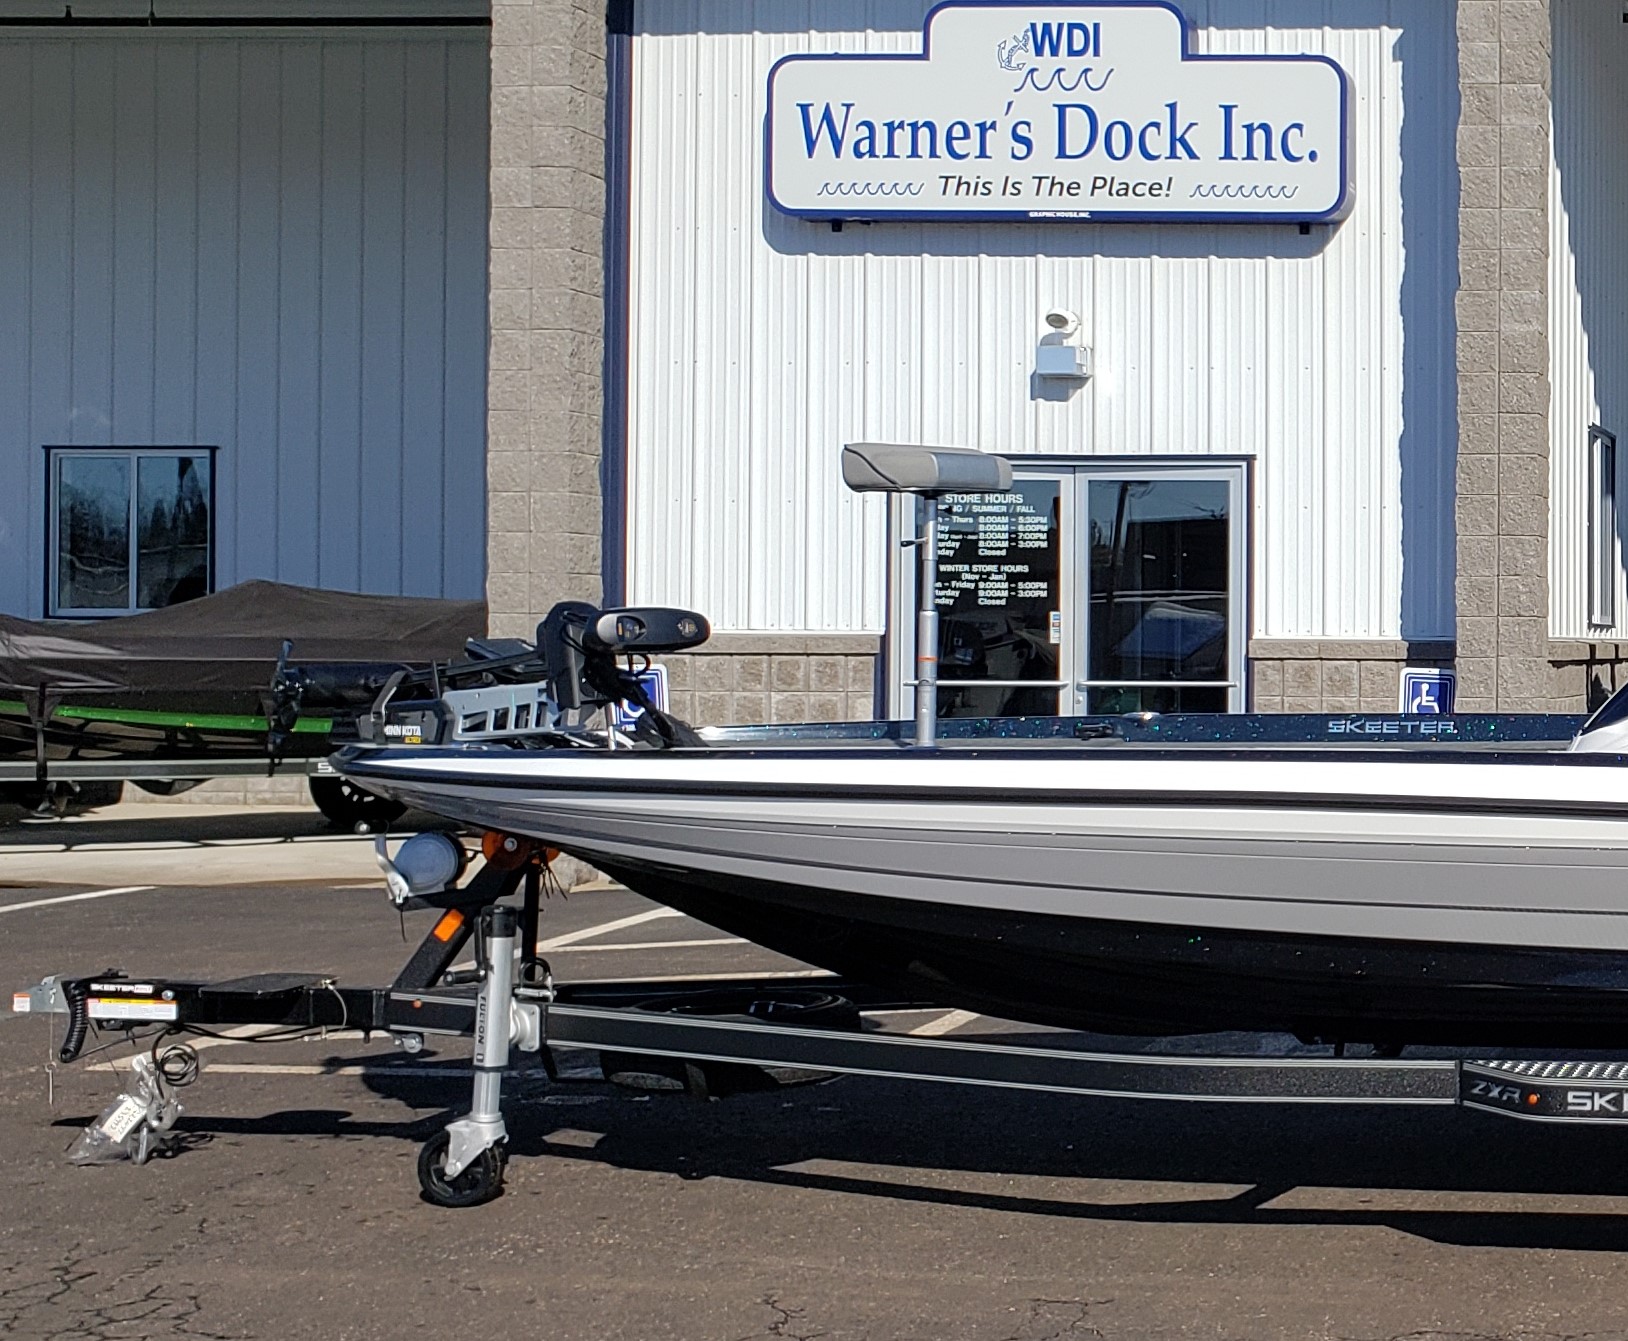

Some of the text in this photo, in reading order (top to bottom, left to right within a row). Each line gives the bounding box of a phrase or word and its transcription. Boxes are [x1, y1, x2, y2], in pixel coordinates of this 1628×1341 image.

[1029, 22, 1100, 57] WDI
[796, 101, 1319, 163] Warner's Dock Inc.
[938, 175, 1173, 199] This Is The Place!
[944, 493, 1024, 504] STORE HOURS
[972, 505, 1008, 513] SUMMER
[1016, 505, 1036, 513] FALL
[937, 540, 960, 549] urday
[978, 548, 1007, 556] Closed
[938, 564, 1030, 573] WINTER STORE HOURS
[951, 581, 976, 590] Friday
[935, 589, 960, 597] turday
[934, 597, 1007, 606] nday Closed
[1327, 718, 1455, 734] SKEETER
[478, 995, 487, 1045] FULTON
[1470, 1080, 1521, 1103] ZXR
